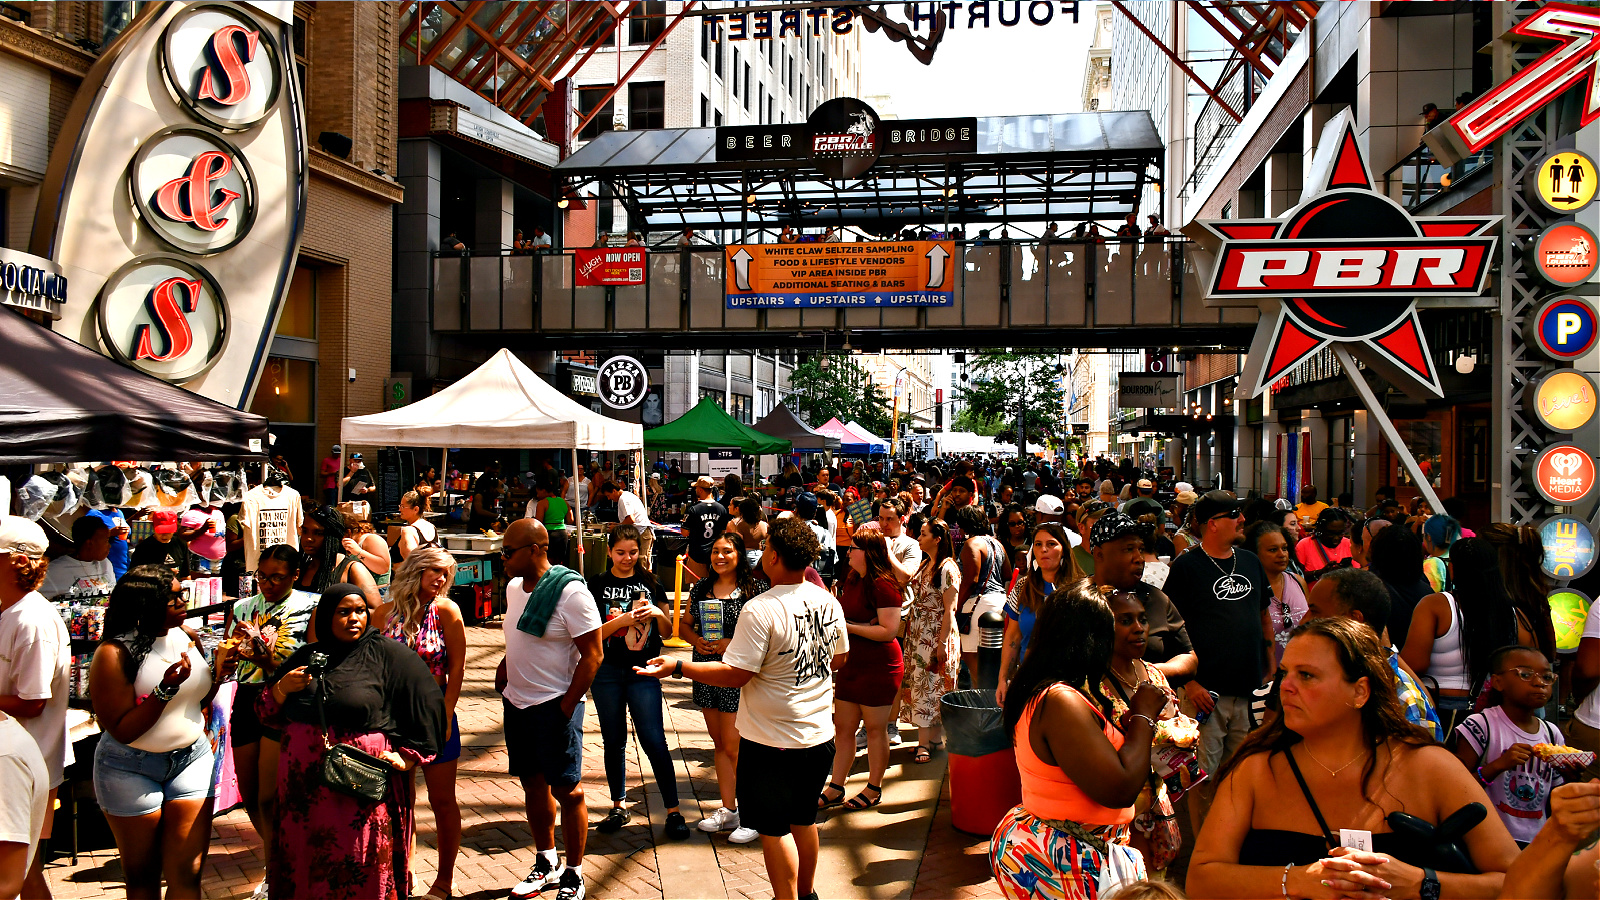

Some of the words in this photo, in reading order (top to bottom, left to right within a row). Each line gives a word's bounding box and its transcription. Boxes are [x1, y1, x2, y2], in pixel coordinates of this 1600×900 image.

[197, 25, 260, 106] S
[726, 134, 792, 149] BEER
[814, 136, 853, 144] PBR
[891, 128, 970, 143] BRIDGE
[578, 254, 602, 275] LAUGH
[606, 252, 622, 262] NOW
[623, 252, 640, 262] OPEN
[1236, 248, 1468, 288] PBR
[731, 297, 784, 306] UPSTAIRS
[810, 296, 866, 304] UPSTAIRS
[890, 294, 946, 304] UPSTAIRS
[134, 276, 204, 362] S
[1557, 312, 1582, 344] P
[604, 362, 639, 378] PIZZA
[614, 375, 631, 390] PB
[1122, 385, 1153, 394] BOURBON
[610, 394, 634, 403] BAR
[1549, 477, 1582, 485] iHeart
[704, 521, 714, 538] 8
[602, 584, 633, 601] SELF
